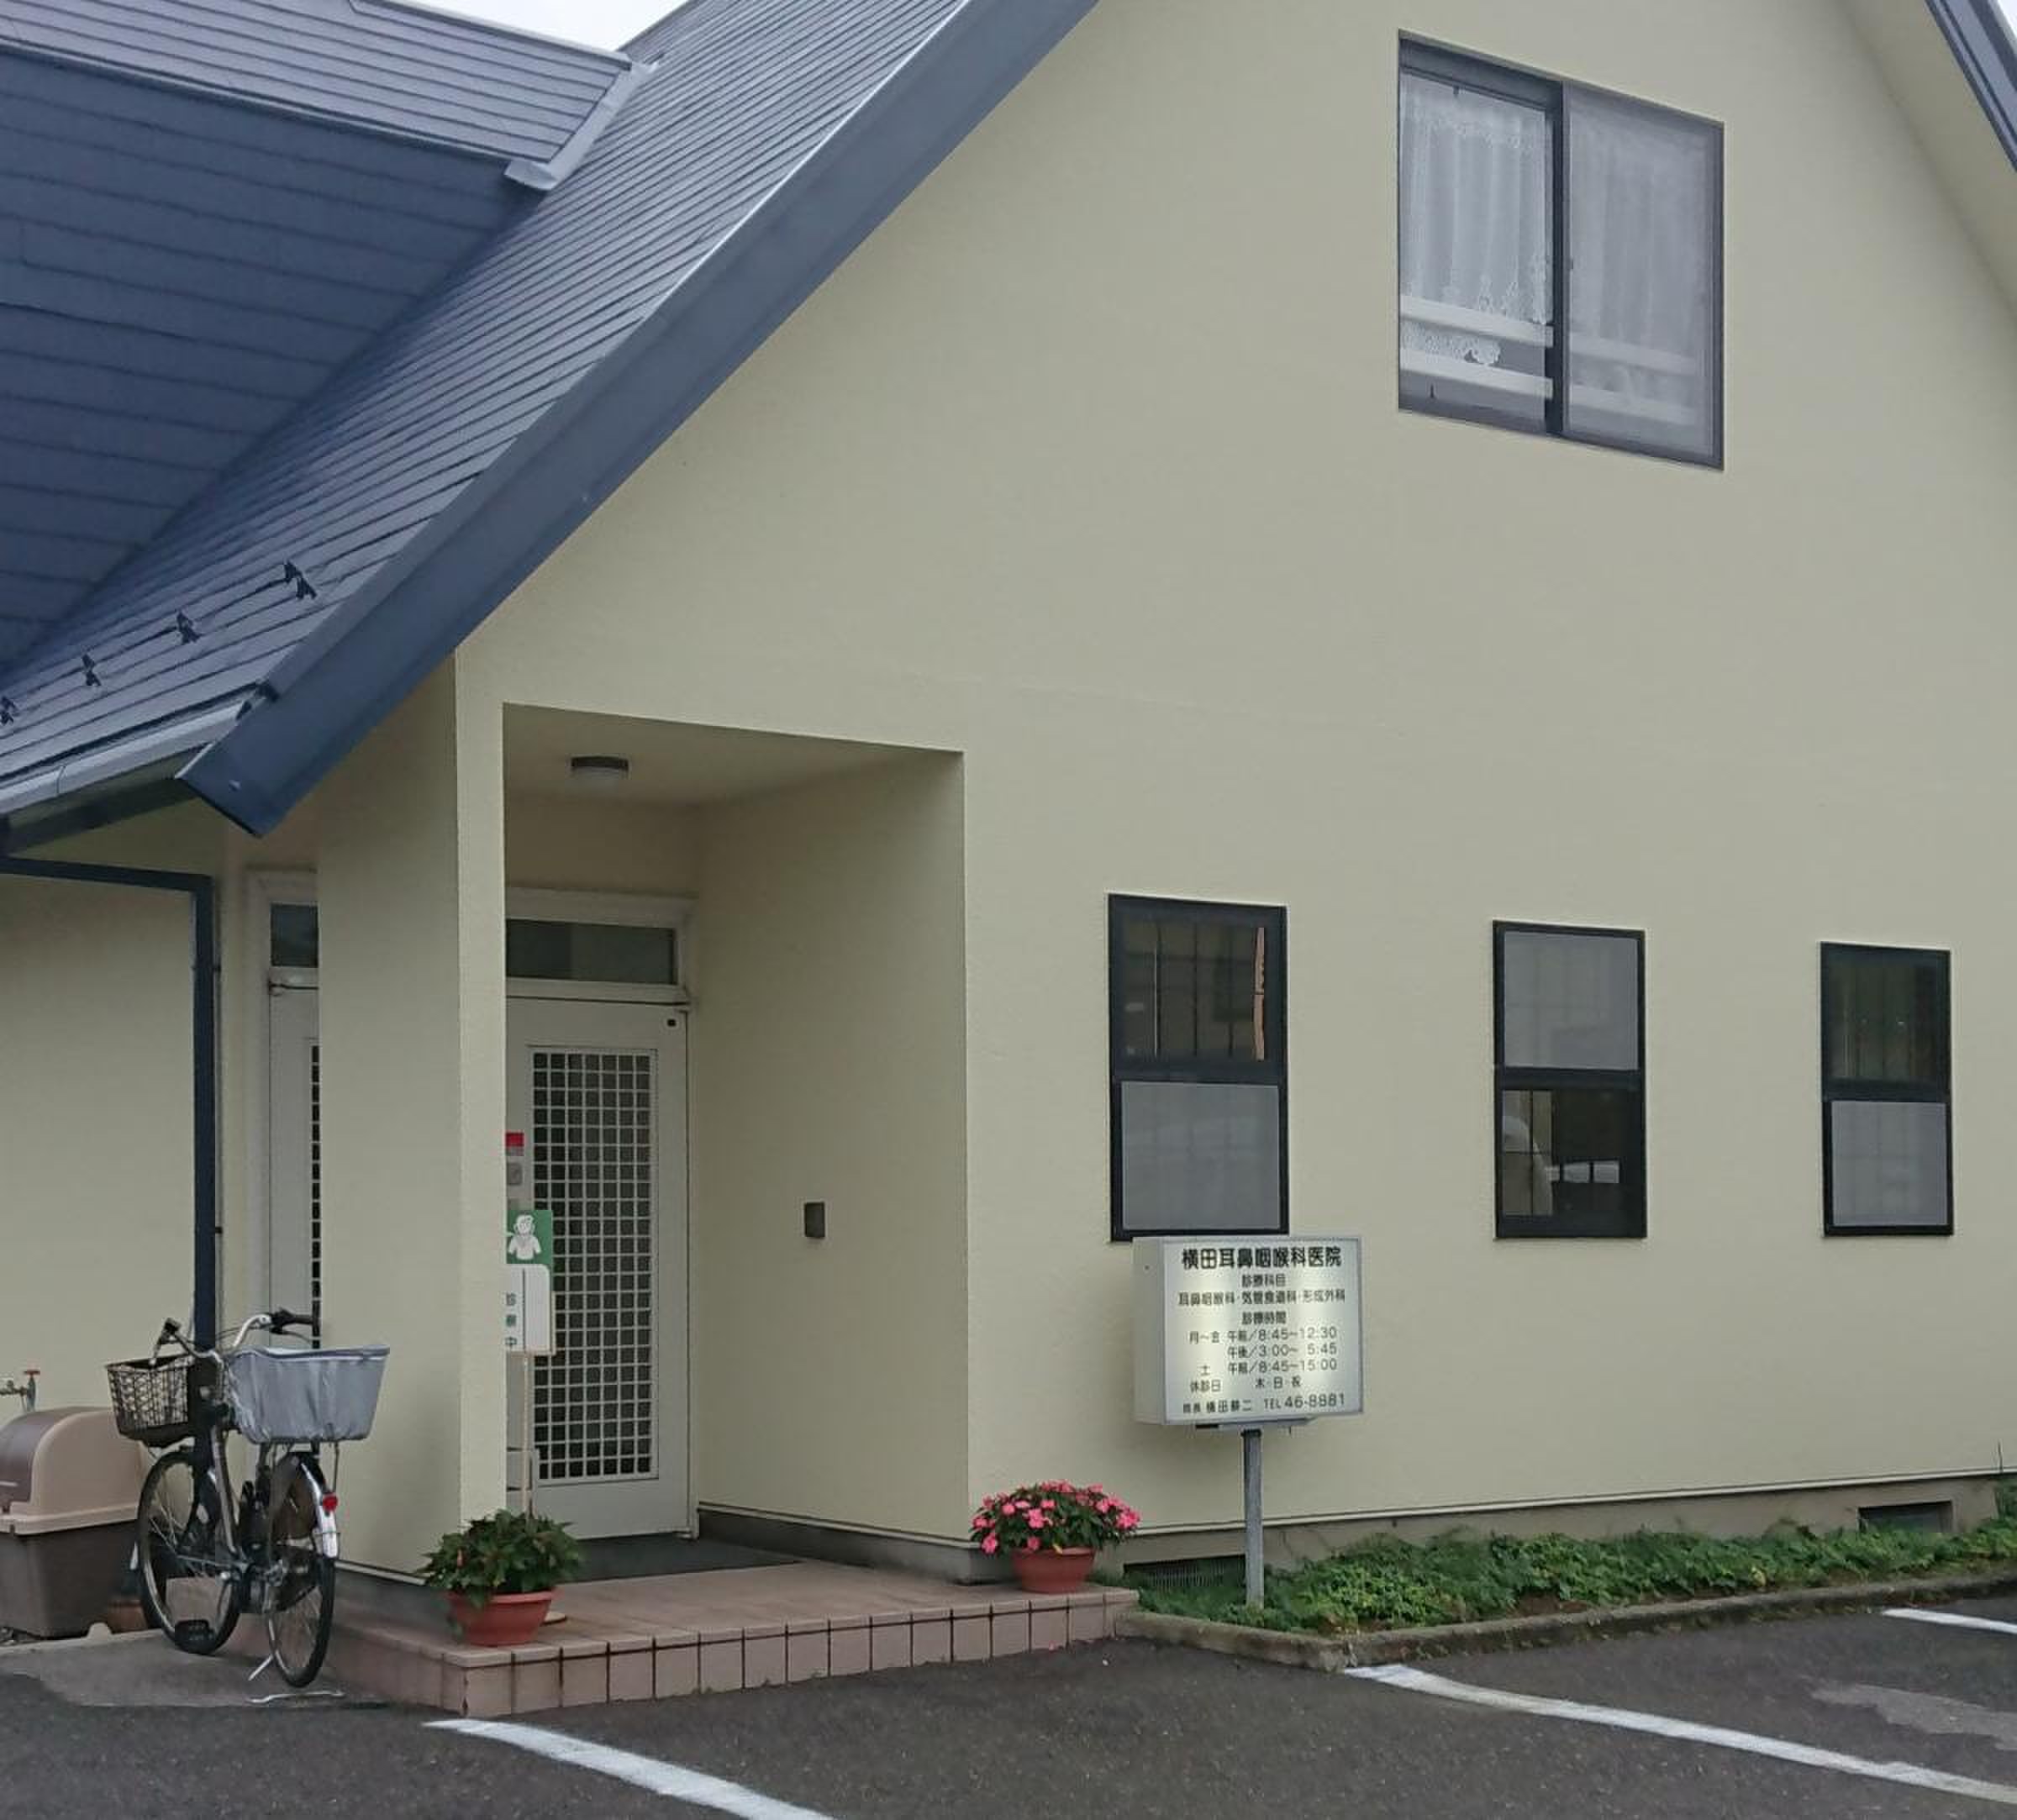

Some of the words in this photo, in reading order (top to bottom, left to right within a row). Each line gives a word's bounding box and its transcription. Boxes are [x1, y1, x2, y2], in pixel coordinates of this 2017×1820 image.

[1182, 1245, 1343, 1270] 横田耳鼻咽喉科医院
[1241, 1273, 1286, 1288] 診療科目
[1241, 1311, 1287, 1325] 診療時間
[1189, 1379, 1222, 1393] 休診日
[1263, 1397, 1282, 1410] TEL
